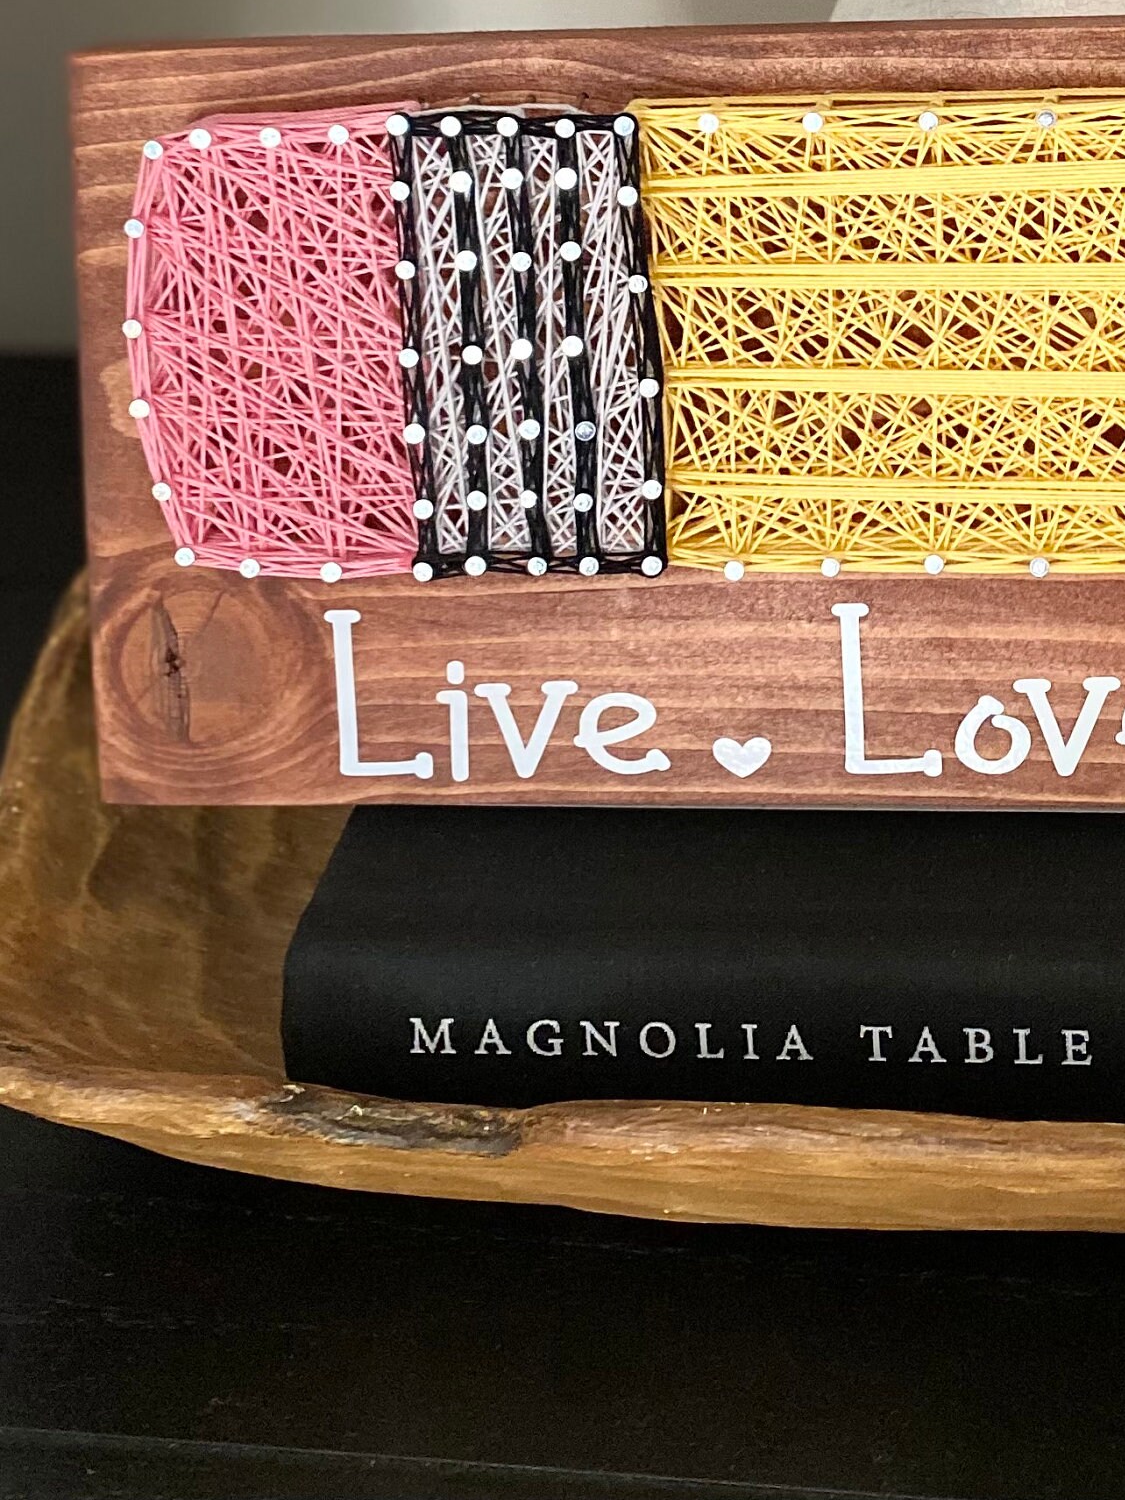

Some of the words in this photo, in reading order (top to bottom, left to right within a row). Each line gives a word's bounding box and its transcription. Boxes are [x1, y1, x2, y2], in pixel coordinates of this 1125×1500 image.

[323, 609, 671, 782] Live
[409, 1017, 815, 1061] MAGNOLIA
[859, 1024, 1095, 1066] TABLE
